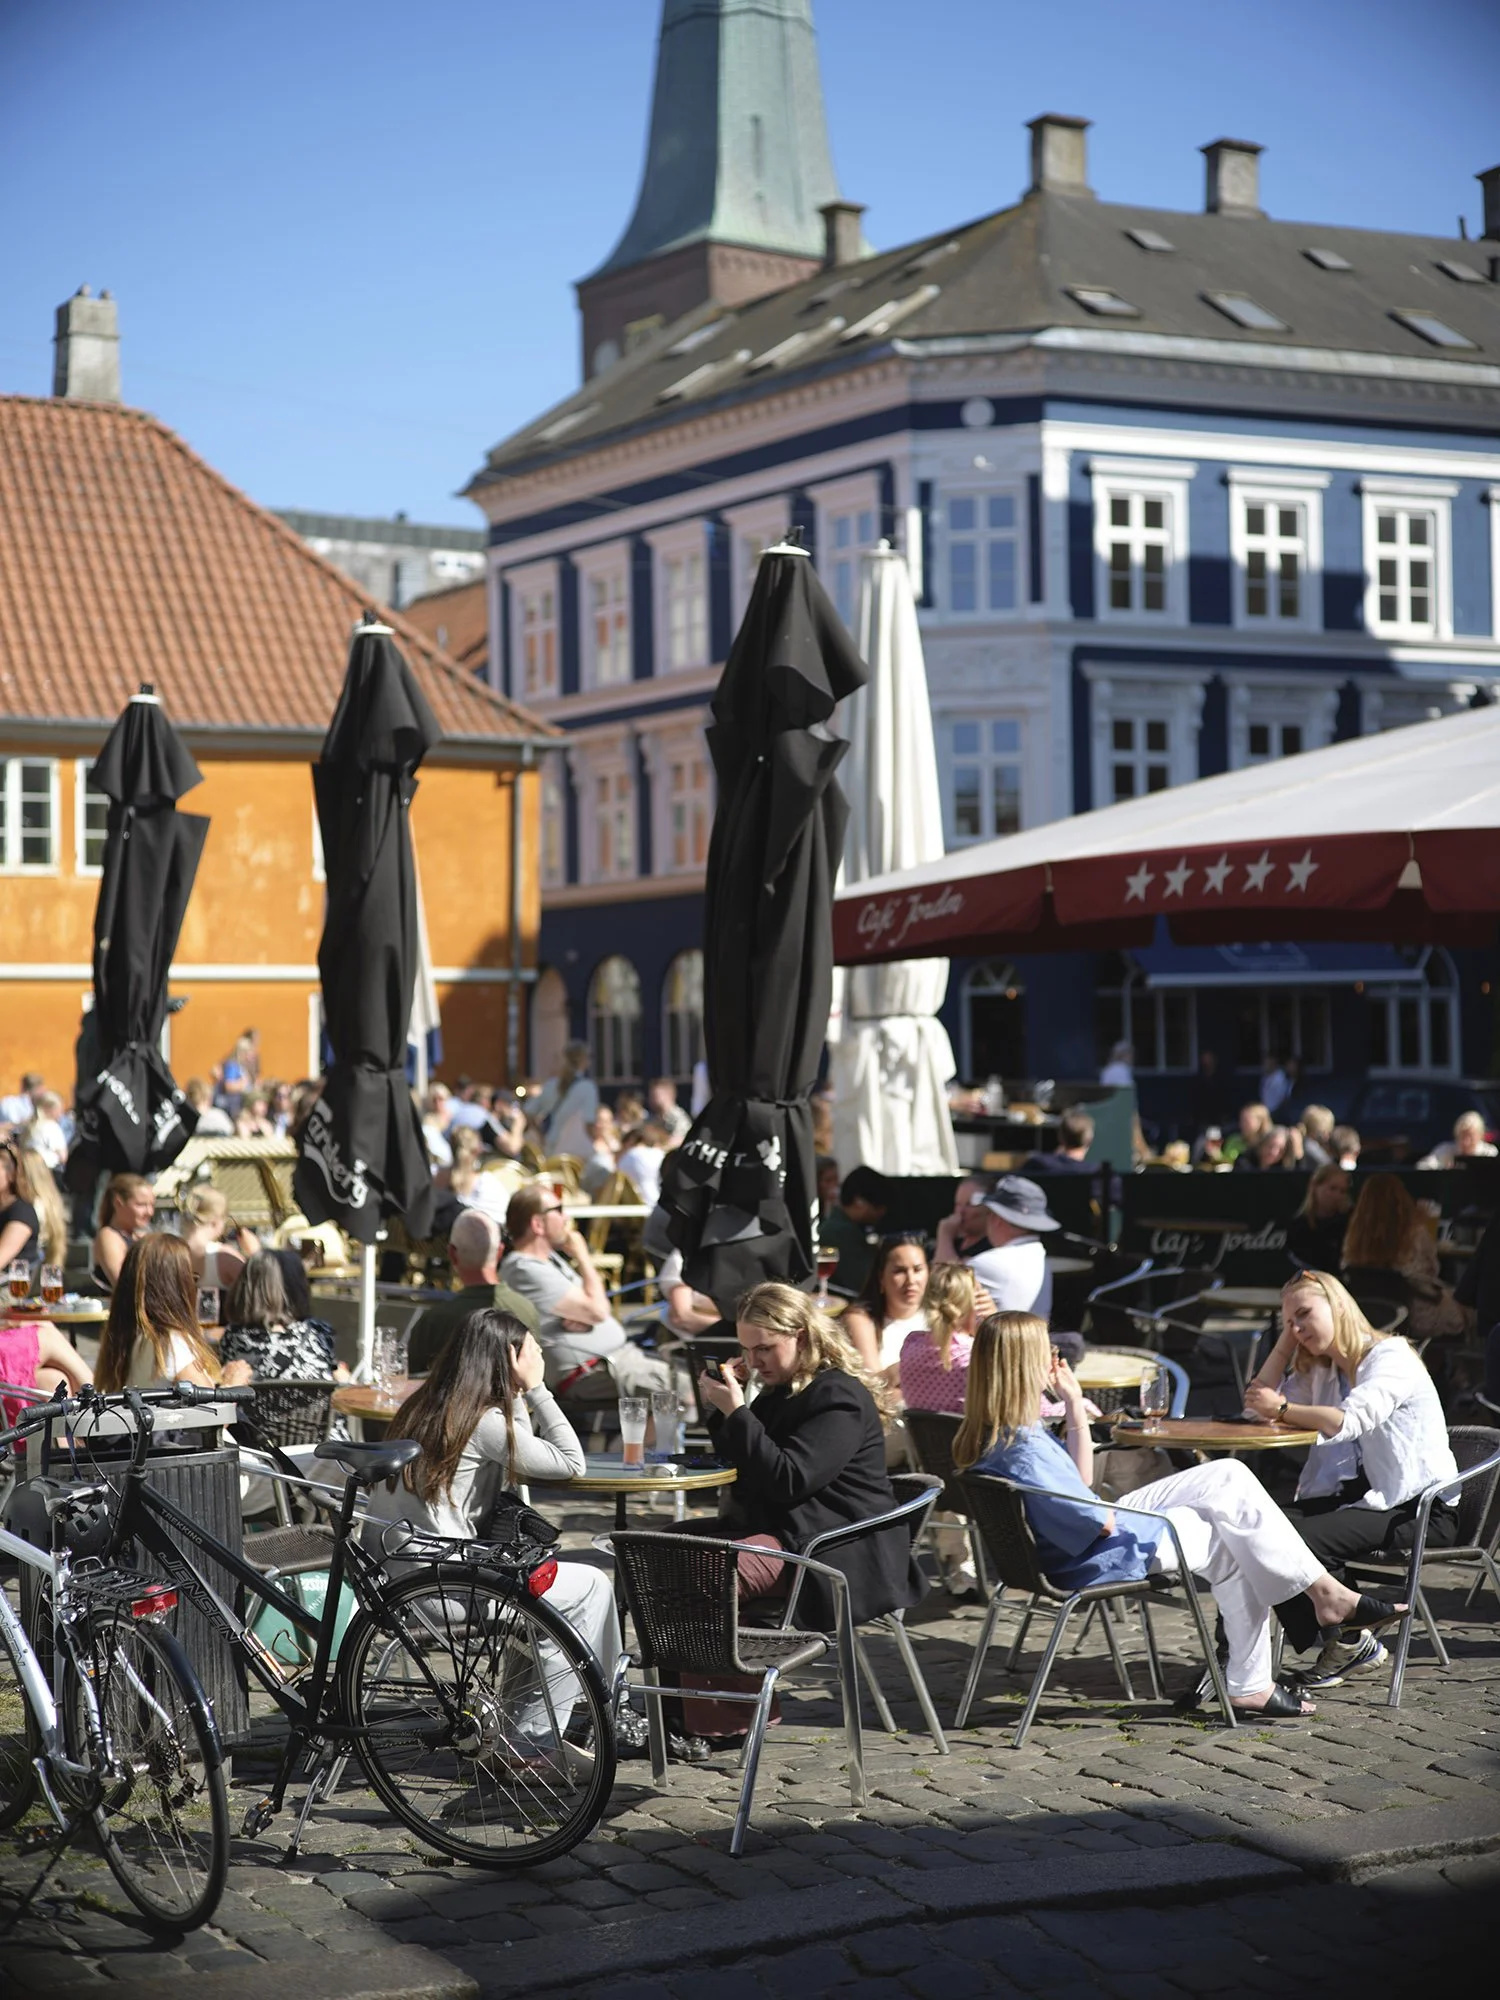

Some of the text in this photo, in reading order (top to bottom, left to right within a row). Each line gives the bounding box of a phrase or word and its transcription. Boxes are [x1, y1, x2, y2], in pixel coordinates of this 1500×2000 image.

[303, 1097, 369, 1209] Carberg
[160, 1508, 203, 1546] TREKKING
[157, 1551, 240, 1644] JENSEN
